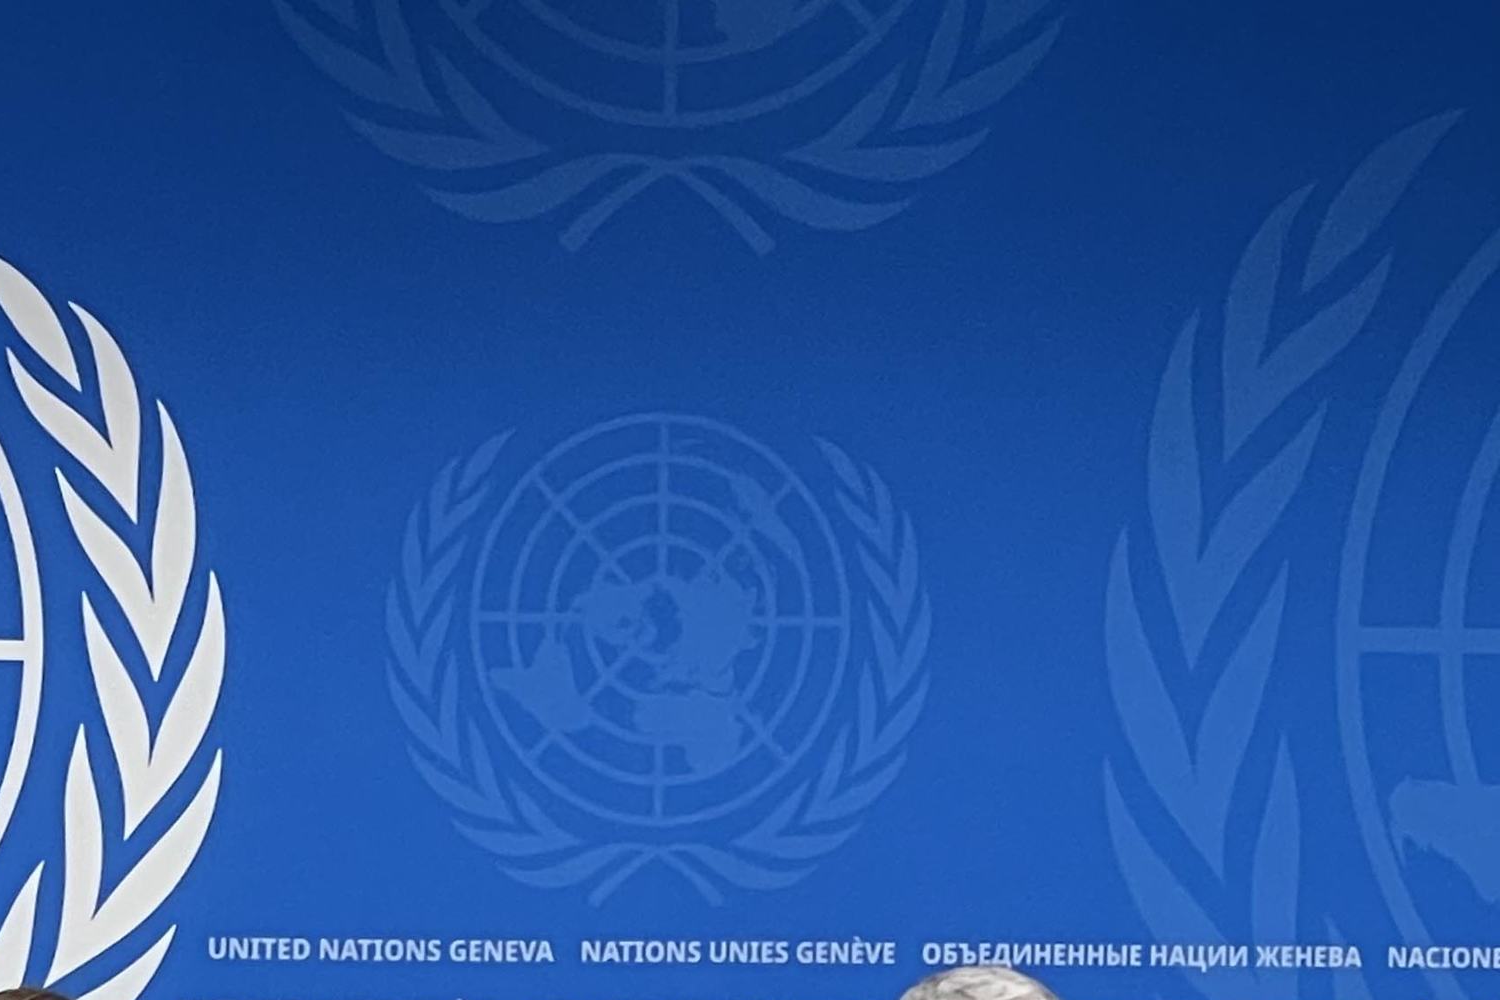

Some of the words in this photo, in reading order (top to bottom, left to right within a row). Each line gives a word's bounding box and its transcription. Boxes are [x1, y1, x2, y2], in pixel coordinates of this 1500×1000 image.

[208, 936, 311, 961] UNITED
[319, 938, 441, 962] NATIONS
[449, 939, 555, 963] GENEVA
[581, 940, 702, 963] NATIONS
[709, 940, 789, 964] UNIES
[796, 935, 896, 965] GENÈVE
[922, 942, 1142, 973] ОБЪЕДИНЕННЫЕ
[1150, 944, 1248, 973] НАЦИИ
[1255, 945, 1362, 968] ЖЕНЕВА
